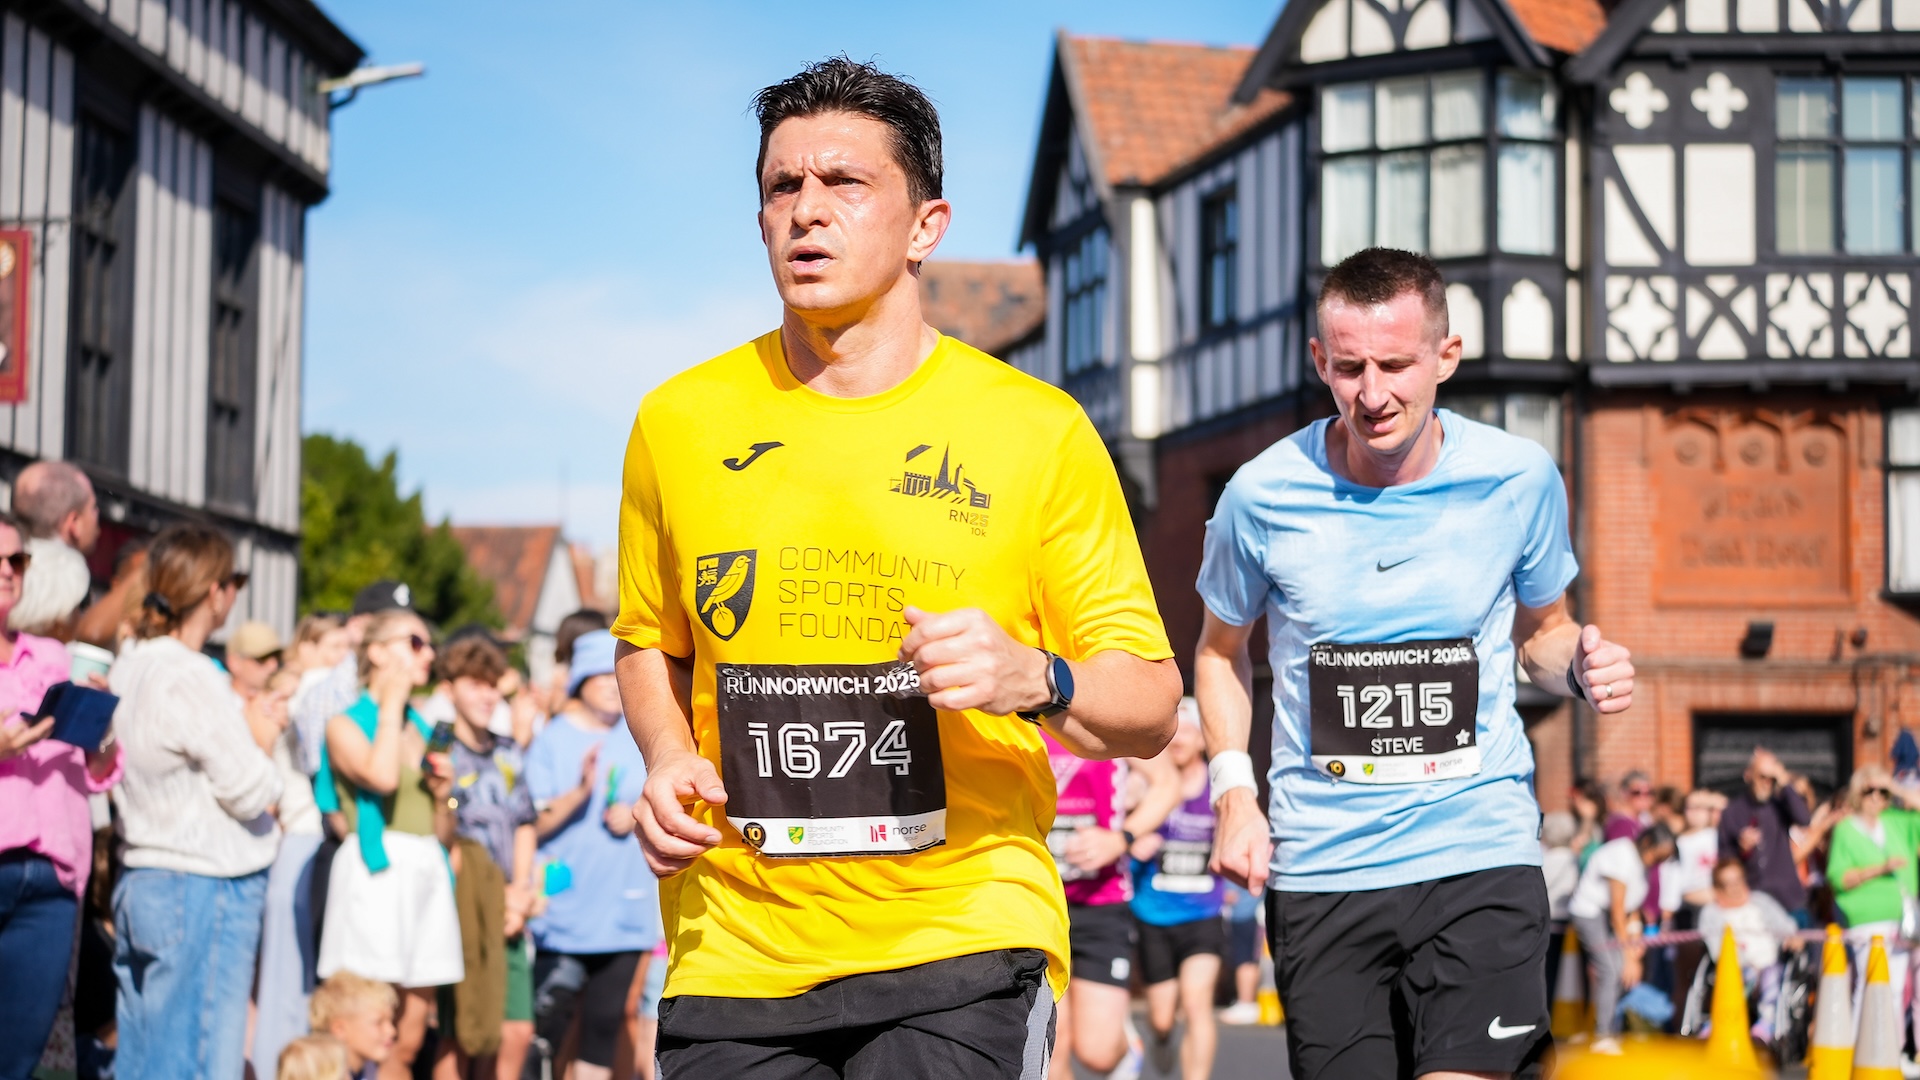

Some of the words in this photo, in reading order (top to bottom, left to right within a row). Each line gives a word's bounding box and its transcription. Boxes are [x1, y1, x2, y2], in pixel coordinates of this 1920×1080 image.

[949, 509, 989, 528] RN25
[971, 527, 987, 537] 10k
[779, 546, 966, 590] COMMUNITY
[779, 579, 905, 612] SPORTS
[1315, 649, 1429, 667] RUNNORWICH
[1432, 646, 1471, 665] 2025
[726, 676, 869, 695] RUNNORWICH
[874, 670, 920, 694] 2025
[1336, 681, 1453, 729] 1215
[748, 720, 912, 779] 1674
[1371, 736, 1424, 754] STEVE
[746, 827, 762, 841] 10
[807, 825, 845, 833] COMMUNITY
[892, 823, 927, 836] norse
[807, 838, 848, 846] FOUNDATION
